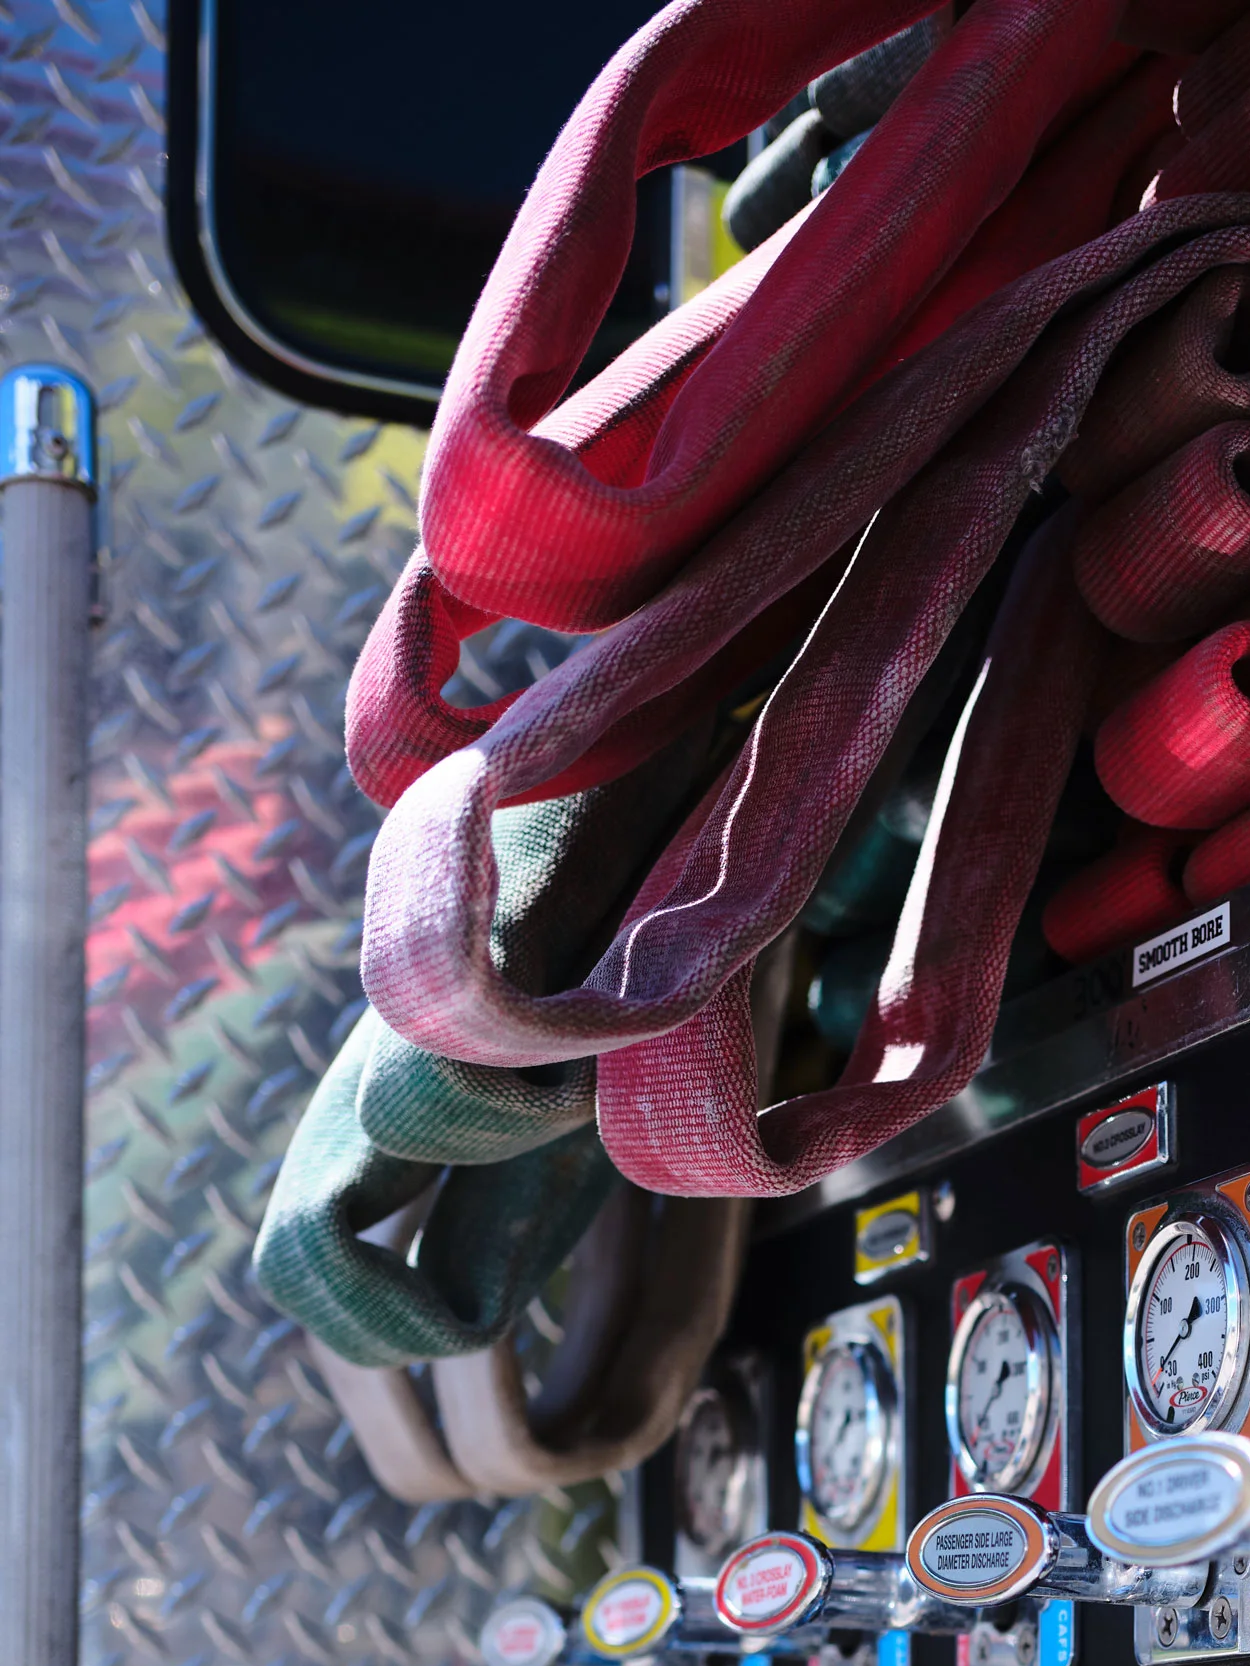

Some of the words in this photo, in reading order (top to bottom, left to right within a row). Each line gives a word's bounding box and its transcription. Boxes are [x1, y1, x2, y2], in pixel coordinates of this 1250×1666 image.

[1139, 932, 1188, 974] SMOOTH
[1191, 914, 1223, 949] BORE
[1185, 1262, 1200, 1280] 200
[1160, 1297, 1172, 1316] 100
[1205, 1297, 1221, 1315] 300
[1198, 1350, 1213, 1369] 400
[1201, 1368, 1210, 1384] psi
[1178, 1389, 1200, 1405] Pierce
[936, 1533, 973, 1550] PASSENGER
[974, 1532, 990, 1549] SIDE
[991, 1531, 1014, 1547] LARGE
[938, 1553, 970, 1570] DIAMETER
[971, 1552, 1009, 1569] DISCHARGE
